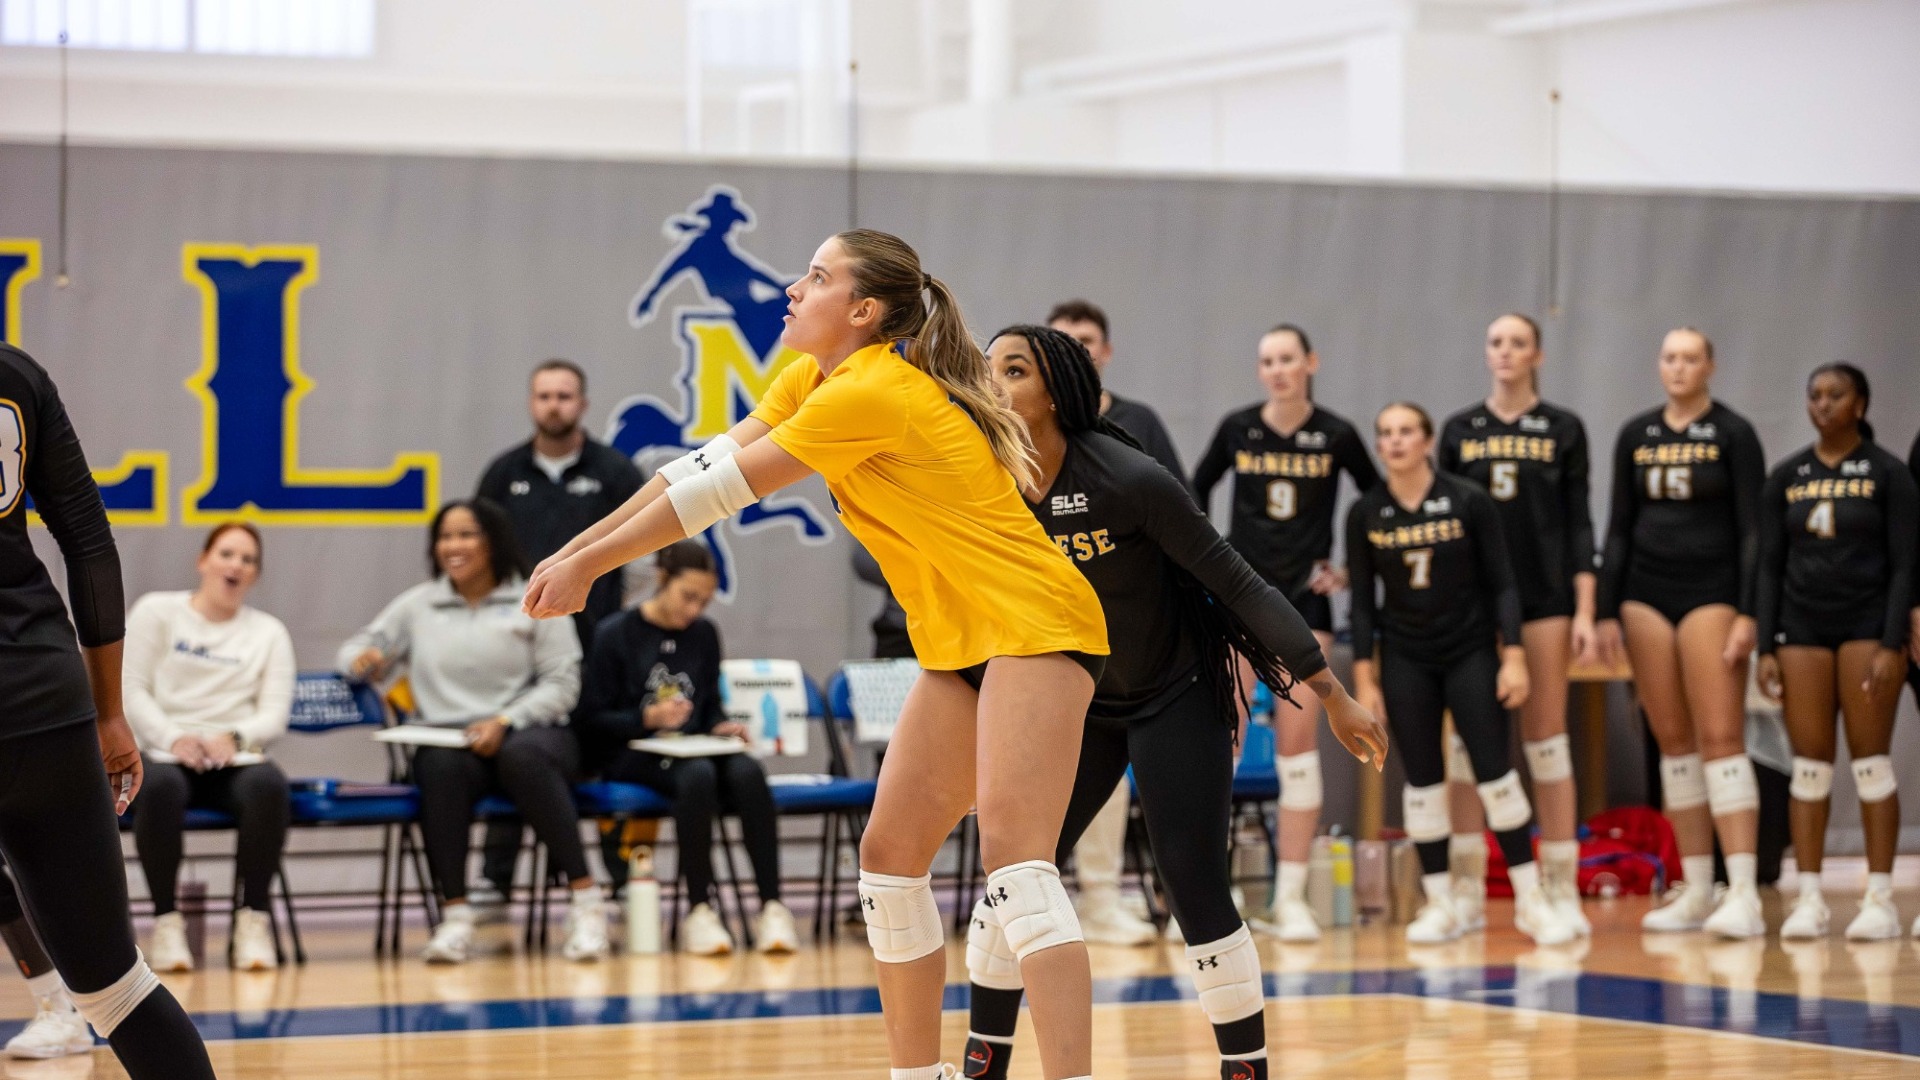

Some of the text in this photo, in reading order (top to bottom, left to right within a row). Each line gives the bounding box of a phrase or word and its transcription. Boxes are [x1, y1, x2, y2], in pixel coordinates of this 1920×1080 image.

[684, 318, 805, 441] M
[1266, 479, 1297, 521] 9
[1490, 461, 1519, 501] 5
[1645, 465, 1692, 500] 15
[1051, 493, 1089, 510] SLC
[1052, 507, 1089, 516] SOUTHLAND
[1805, 499, 1837, 539] 4
[1048, 529, 1116, 561] ESE
[1402, 547, 1434, 589] 7
